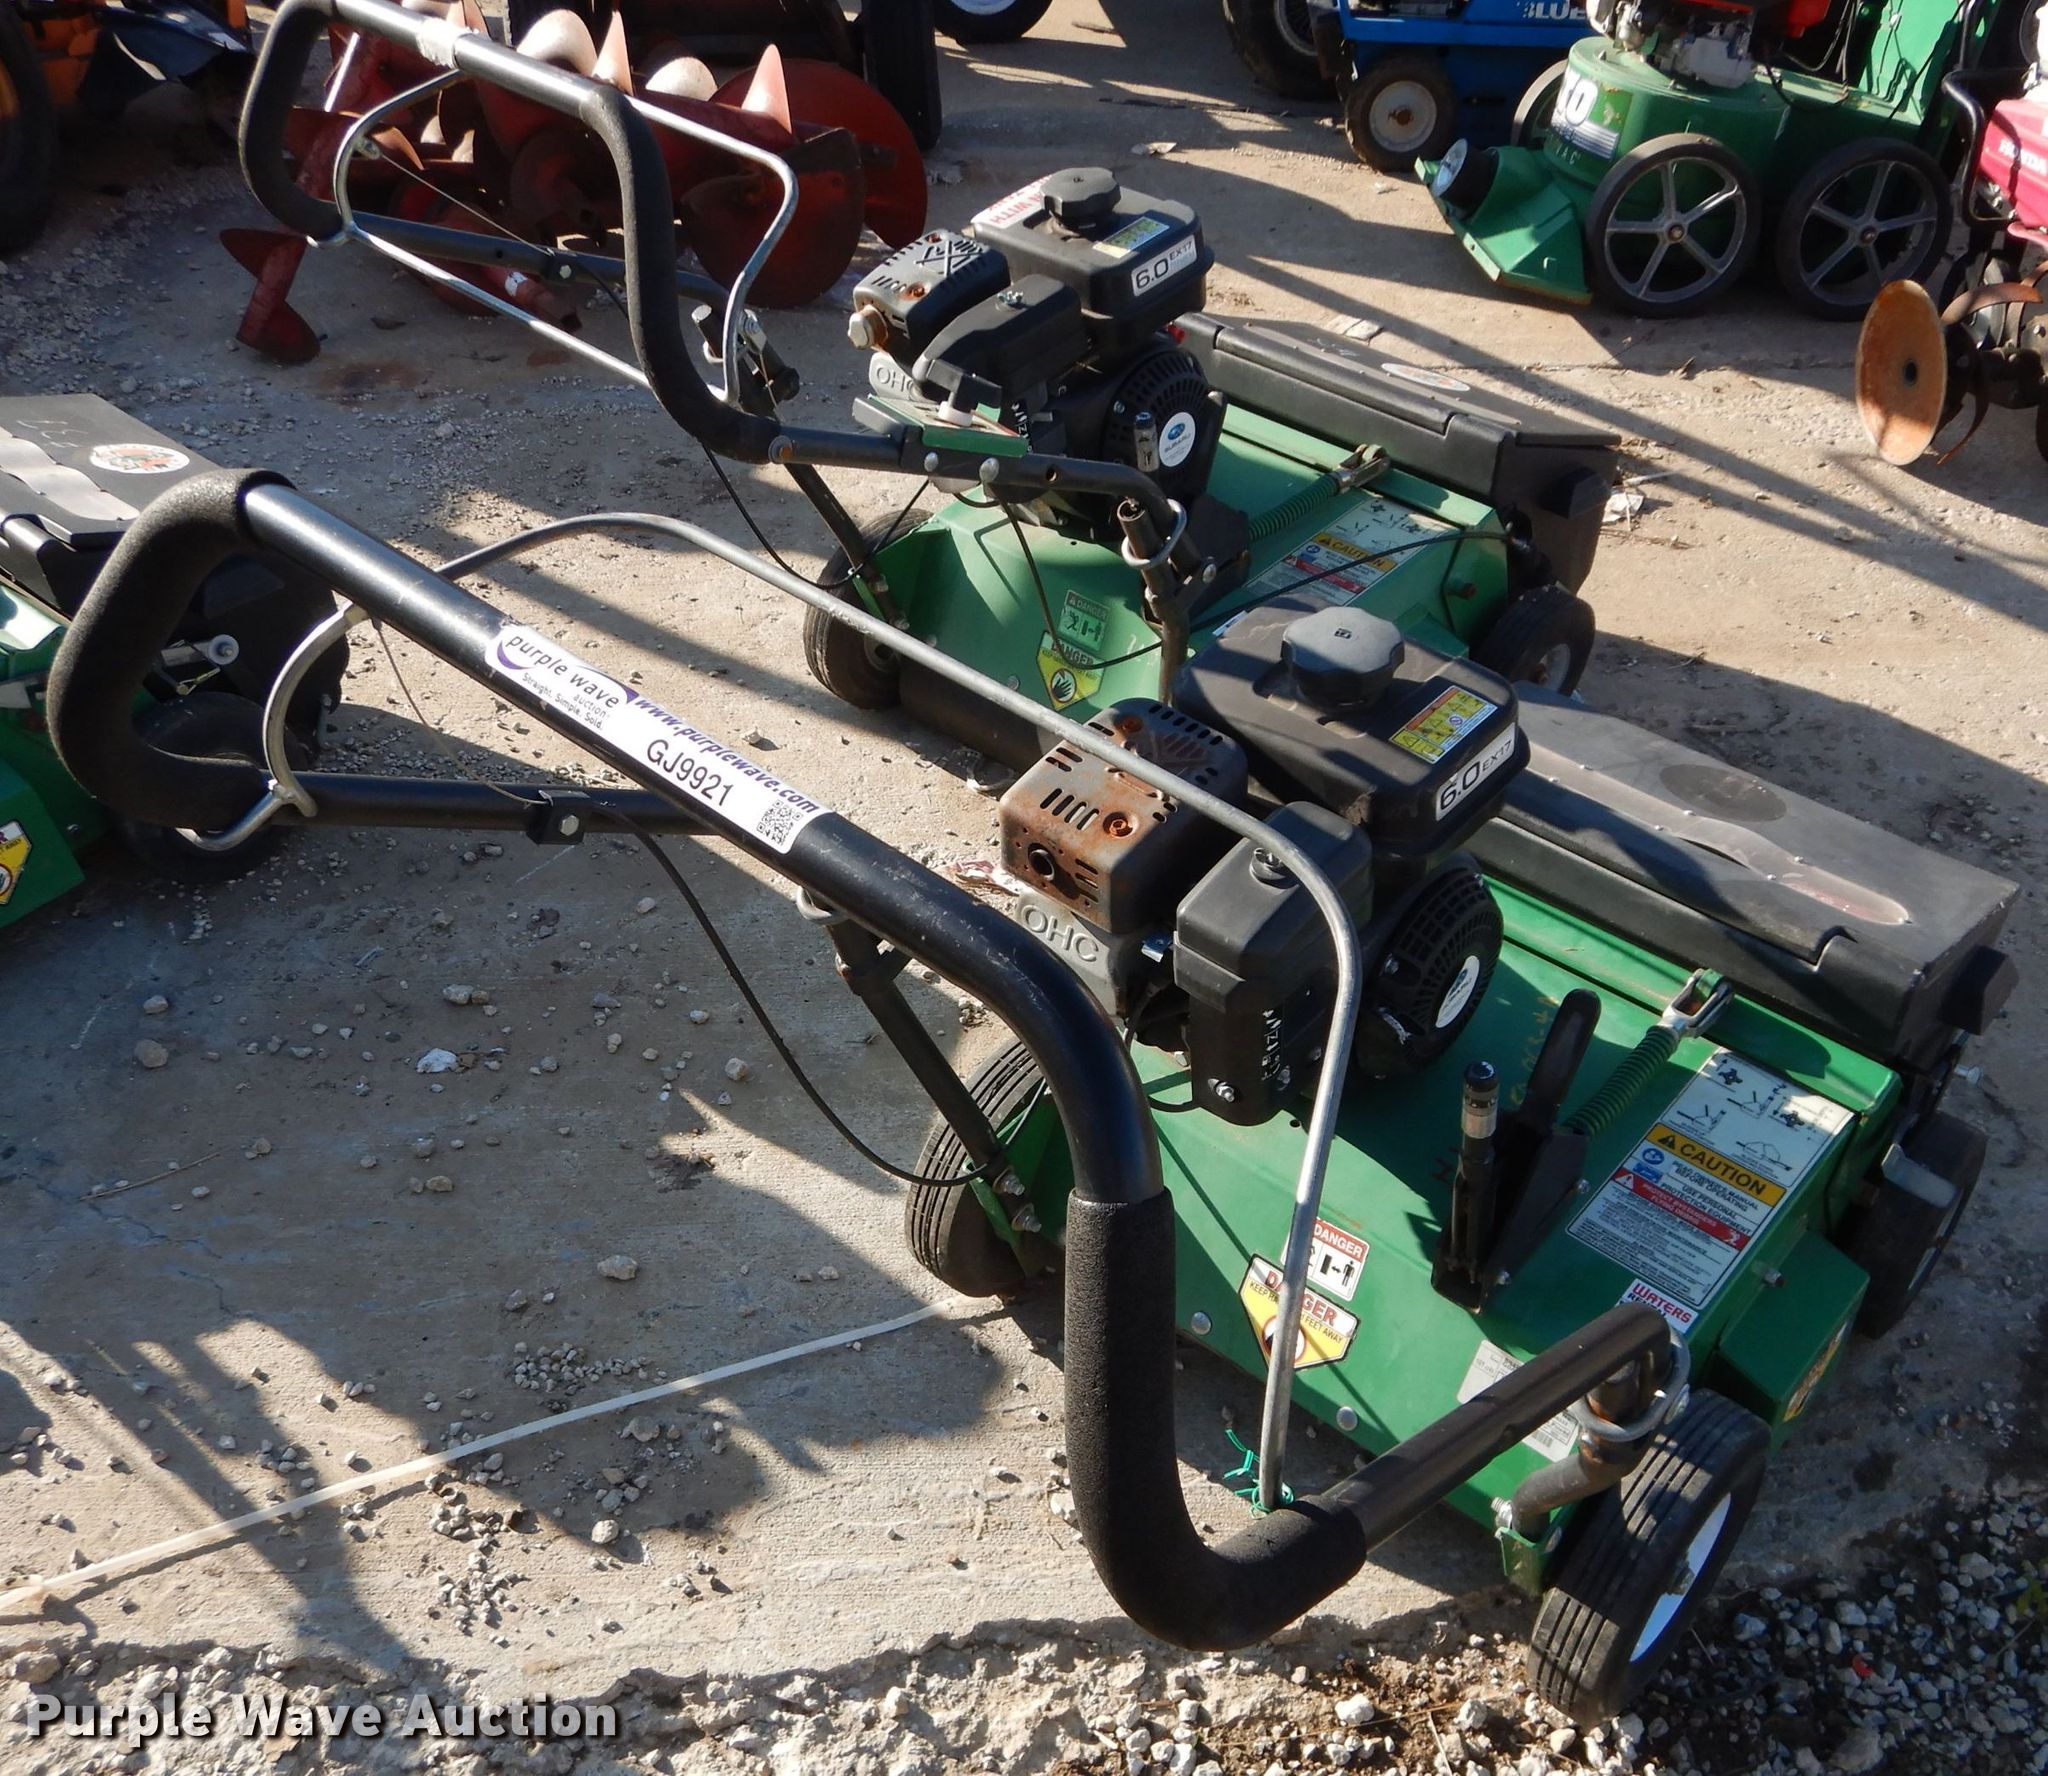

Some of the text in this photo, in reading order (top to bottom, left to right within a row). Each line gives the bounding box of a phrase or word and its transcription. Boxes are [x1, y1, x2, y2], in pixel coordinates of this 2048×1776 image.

[1136, 258, 1169, 290] 6.0
[505, 633, 620, 708] purple wave
[636, 697, 821, 813] www.purplewave.com
[646, 738, 734, 807] GJ9921
[1440, 740, 1512, 810] 6.0 EX17
[1021, 904, 1099, 962] OHC
[1680, 1142, 1767, 1196] CAUTION
[1314, 1223, 1363, 1257] DANGER
[1250, 1282, 1268, 1299] KEEP
[1264, 1270, 1338, 1327] DGER
[1632, 1283, 1692, 1323] WATERS
[1305, 1316, 1344, 1344] FEET AWAY
